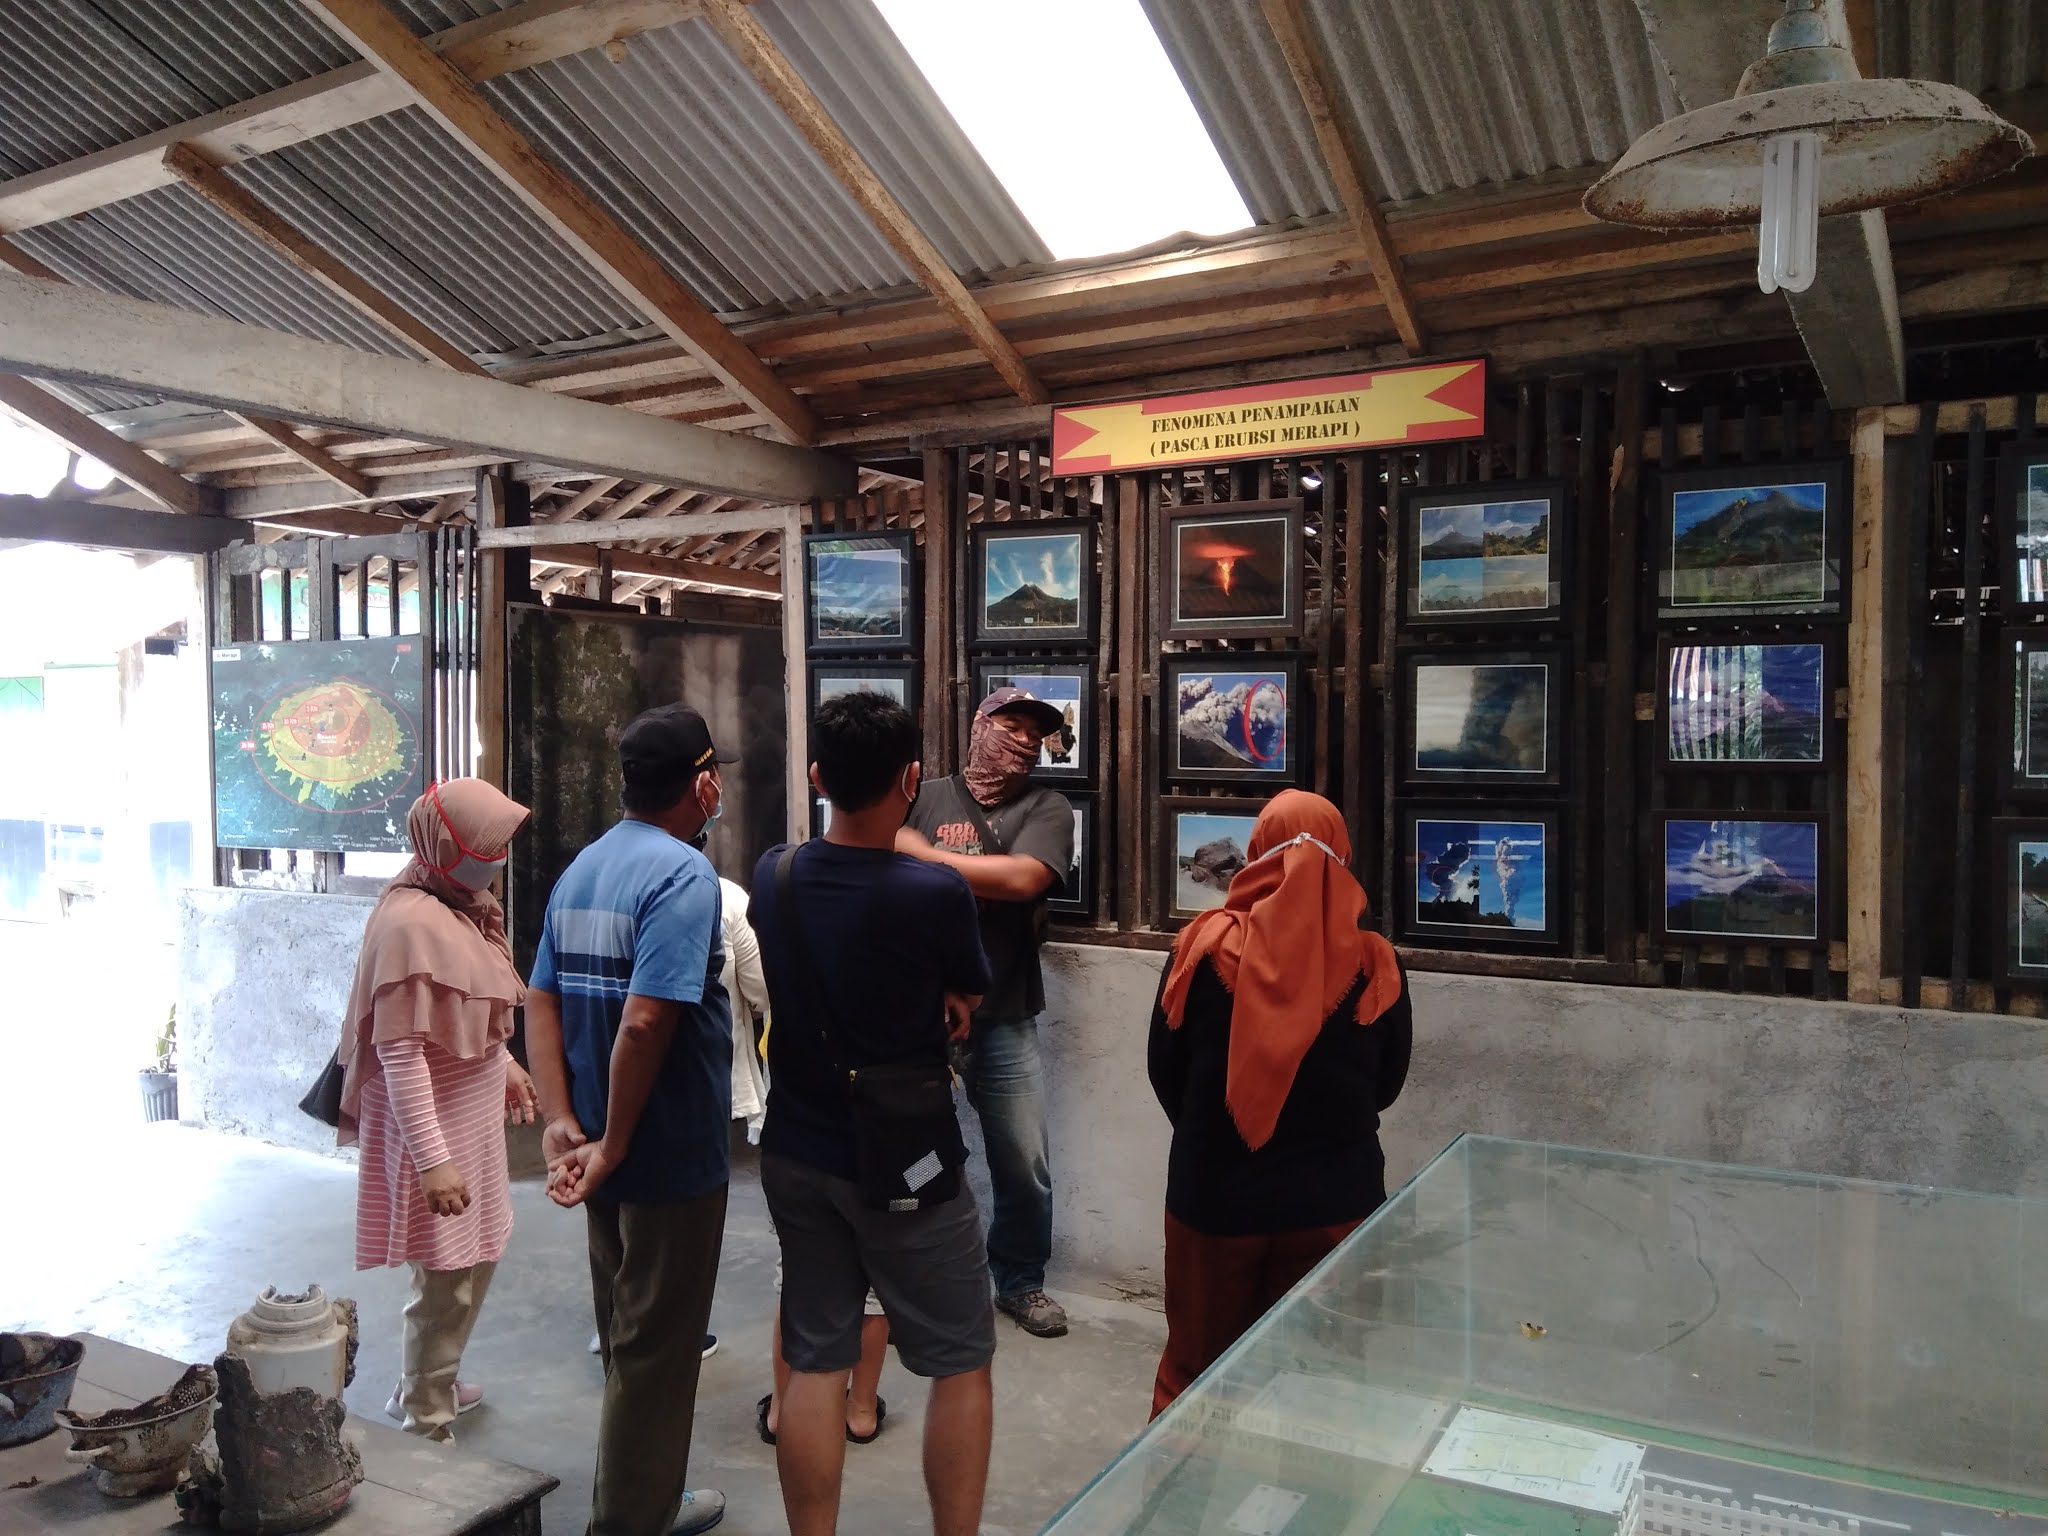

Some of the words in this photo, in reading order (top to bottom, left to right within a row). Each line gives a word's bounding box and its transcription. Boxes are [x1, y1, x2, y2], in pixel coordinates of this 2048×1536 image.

[1151, 410, 1237, 434] FENOMENA
[1241, 396, 1361, 424] PENAMPAKAN
[1214, 429, 1277, 449] ERUBSI
